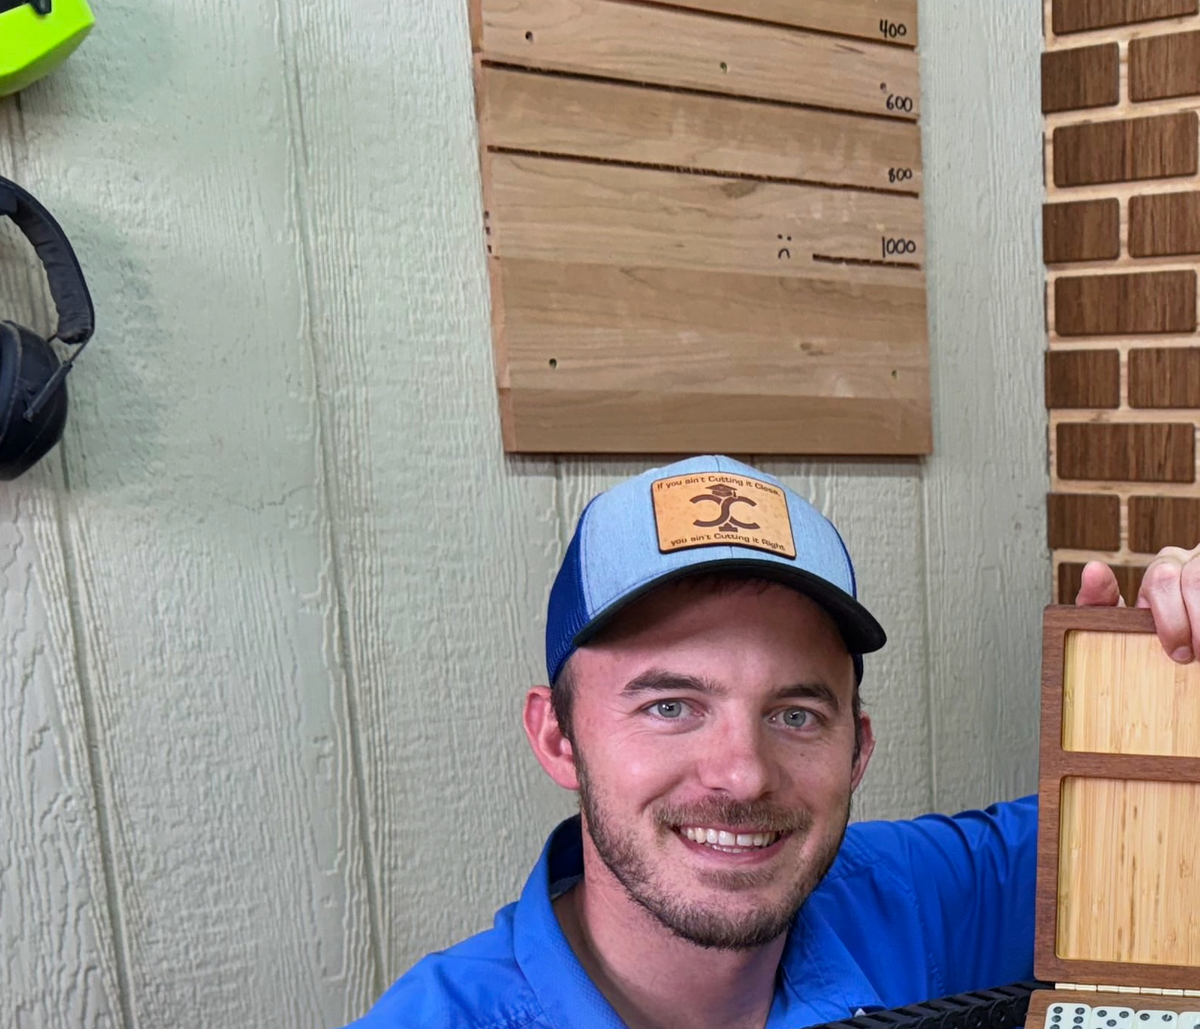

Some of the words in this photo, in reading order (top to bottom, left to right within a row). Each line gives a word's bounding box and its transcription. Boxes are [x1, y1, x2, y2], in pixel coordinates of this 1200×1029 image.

[879, 19, 907, 39] 400
[886, 93, 913, 113] 600
[888, 167, 913, 183] 800
[881, 236, 917, 259] 1000
[657, 482, 663, 490] If
[666, 480, 682, 489] you
[685, 476, 706, 485] ain't
[708, 475, 744, 487] Cutting
[746, 479, 753, 487] it
[670, 537, 688, 547] you
[690, 534, 712, 542] ain't
[713, 532, 750, 543] Cutting
[752, 536, 760, 544] it
